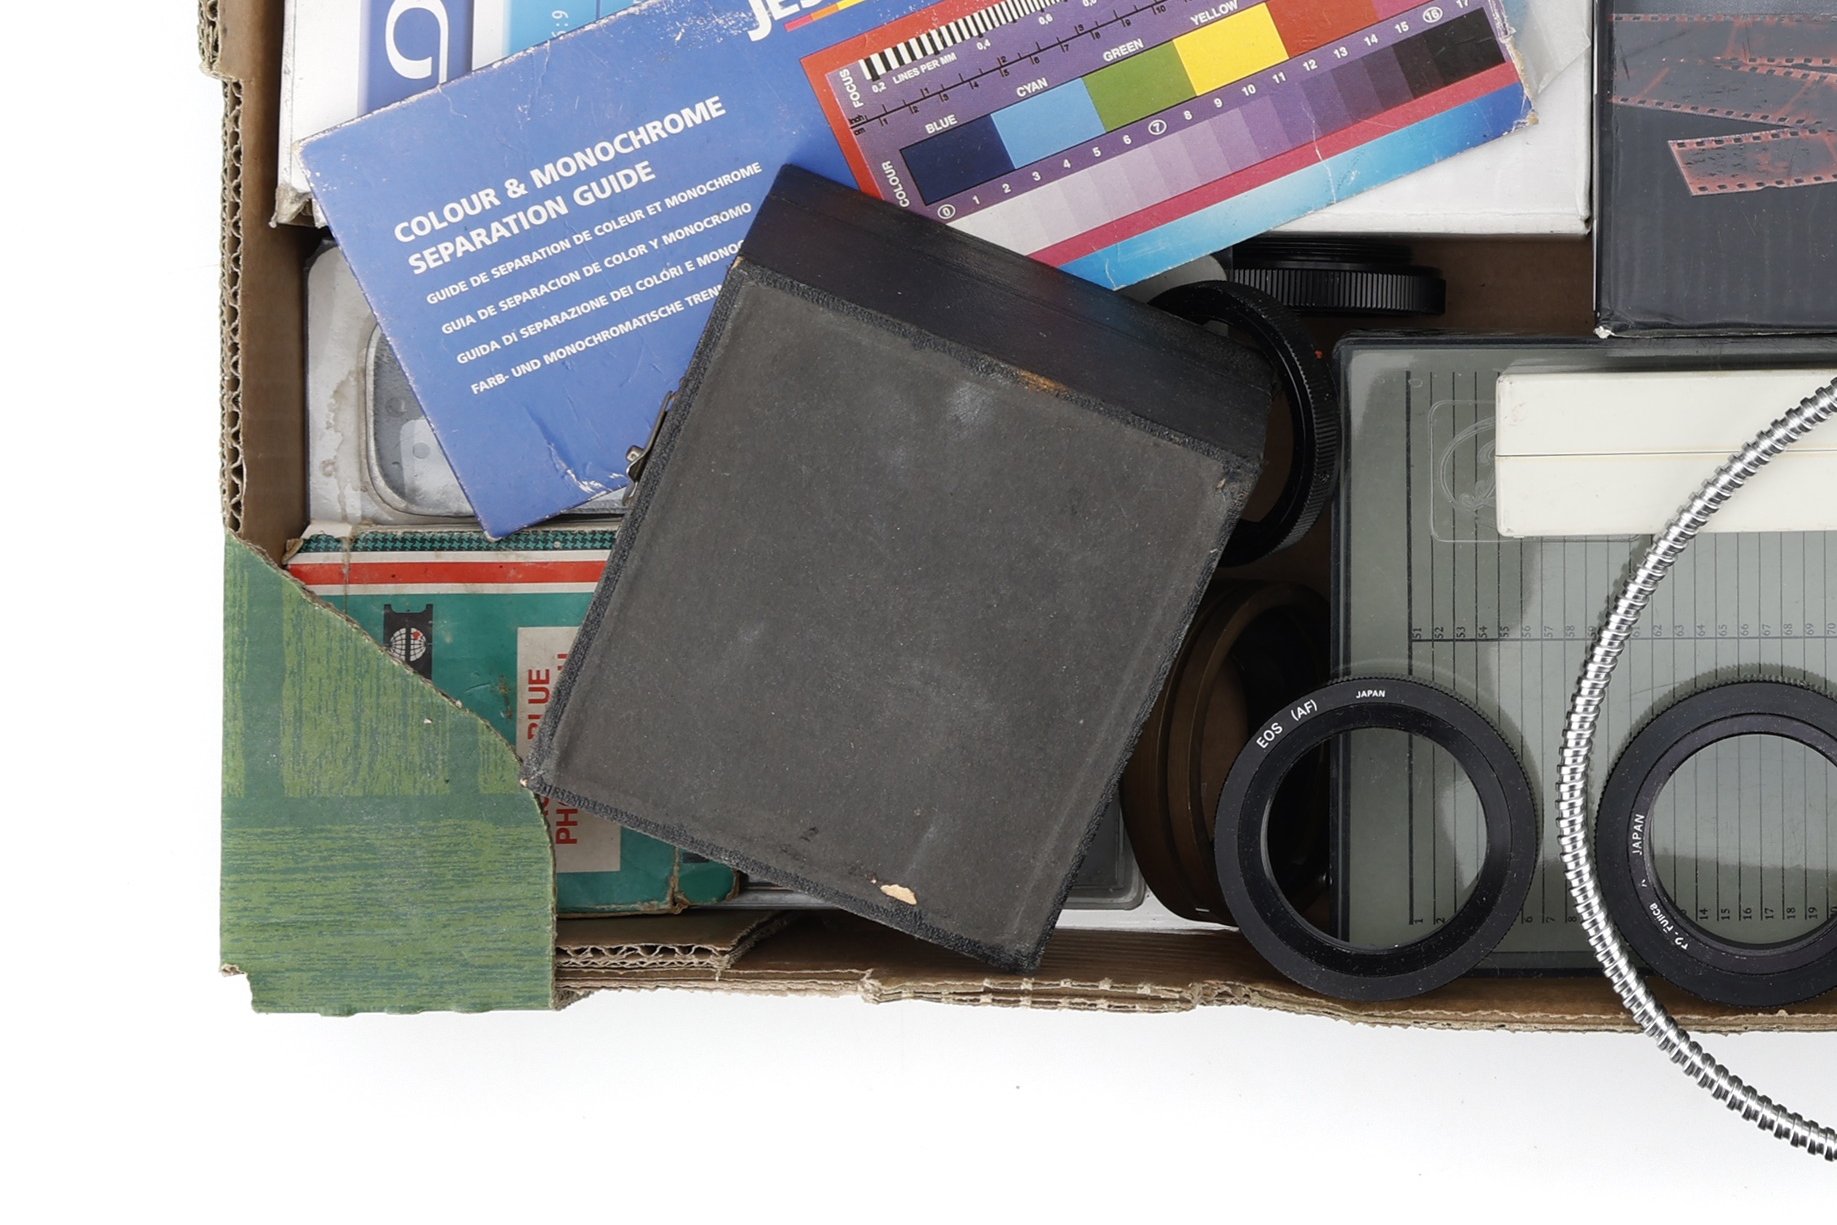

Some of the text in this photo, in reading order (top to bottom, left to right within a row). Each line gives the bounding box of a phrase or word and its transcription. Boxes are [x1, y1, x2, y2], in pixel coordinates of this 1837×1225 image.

[839, 68, 864, 109] FOCUS
[871, 81, 887, 94] 0,2
[892, 67, 920, 85] LINES
[920, 59, 937, 74] PER
[937, 52, 957, 67] MM
[976, 39, 991, 52] 0,4
[925, 114, 958, 135] BLUE
[1016, 77, 1049, 98] CYAN
[1103, 38, 1144, 63] GREEN
[1241, 84, 1257, 97] 10
[1272, 71, 1287, 84] 11
[1303, 58, 1318, 72] 12
[1334, 46, 1349, 59] 13
[1363, 33, 1379, 46] 14
[1394, 21, 1410, 34] 15
[1425, 8, 1440, 21] 16
[394, 95, 727, 244] COLOUR & MONOCHROME
[880, 160, 911, 208] COLOUR
[408, 160, 656, 275] SEPARATION GUIDE
[426, 161, 763, 306] GUIDE DE SEPARATION DE COLEUR ET MONOCHROME
[441, 202, 752, 336] GUIA DE SEPARACION DE COLOR Y MONOCROMO
[456, 341, 501, 365] GUIDA
[501, 331, 519, 346] DI
[519, 295, 609, 340] SEPARAZIONE
[610, 286, 634, 303] DEI
[635, 264, 684, 293] COLORI
[684, 260, 696, 272] E
[470, 373, 511, 395] FARB-
[511, 357, 542, 379] UND
[542, 300, 685, 366] MONOCHROMATISCHE
[1256, 689, 1386, 749] EOS (AF) JAPAN
[1632, 813, 1645, 856] JAPAN
[1742, 907, 1752, 920] 16
